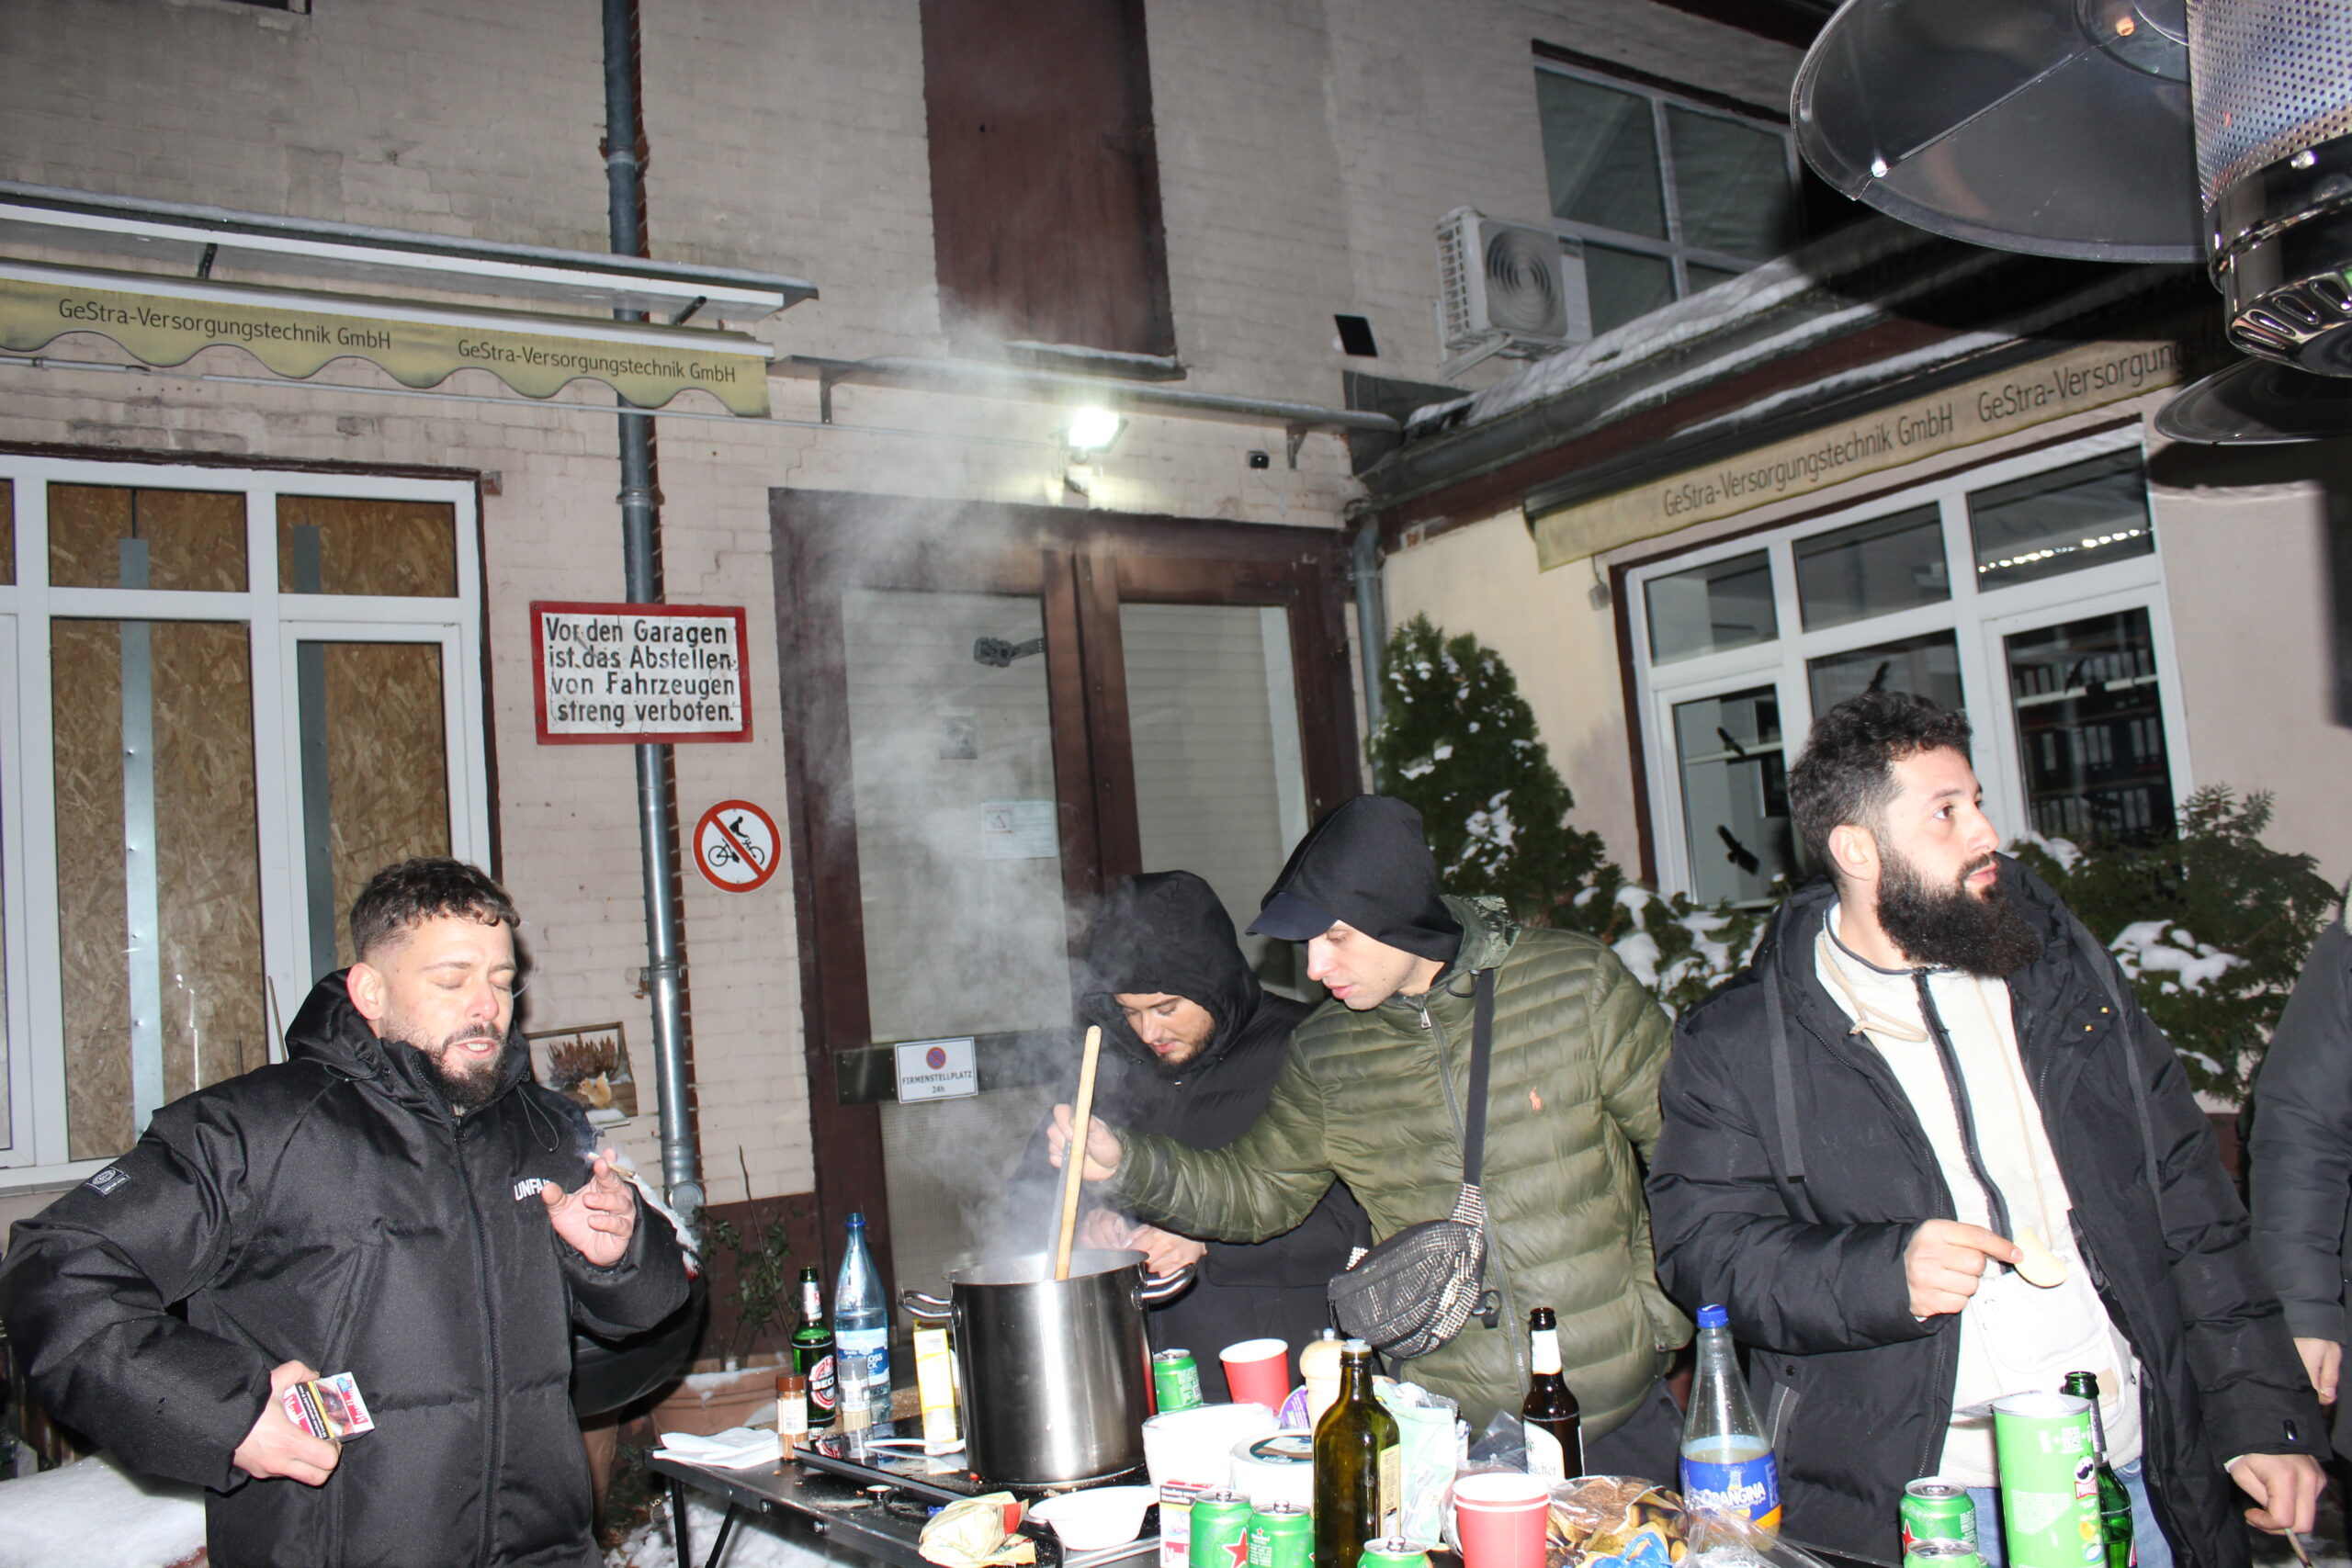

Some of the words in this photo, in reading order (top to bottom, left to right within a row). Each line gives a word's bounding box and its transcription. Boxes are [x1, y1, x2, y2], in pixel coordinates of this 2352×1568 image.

[59, 298, 332, 344] GeStra-Versorgungstechnik
[337, 328, 391, 350] GmbH
[458, 339, 684, 378] GeStra-Versorgungstechnik
[690, 362, 736, 383] GmbH
[1663, 427, 1894, 517] GeStra-Versorgungstechnik
[1897, 402, 1954, 446] GmbH
[546, 617, 580, 641] Vor
[586, 619, 623, 642] den
[634, 619, 727, 647] Garagen
[548, 645, 574, 669] ist
[582, 646, 621, 669] das
[629, 646, 731, 671] Abstellen
[551, 678, 594, 695] von
[605, 671, 735, 700] Fahrzeugen
[558, 702, 625, 727] streng
[635, 699, 734, 723] verboten.
[902, 1070, 973, 1085] FIRMENSTELLPLATZ
[514, 1178, 551, 1201] UNFA
